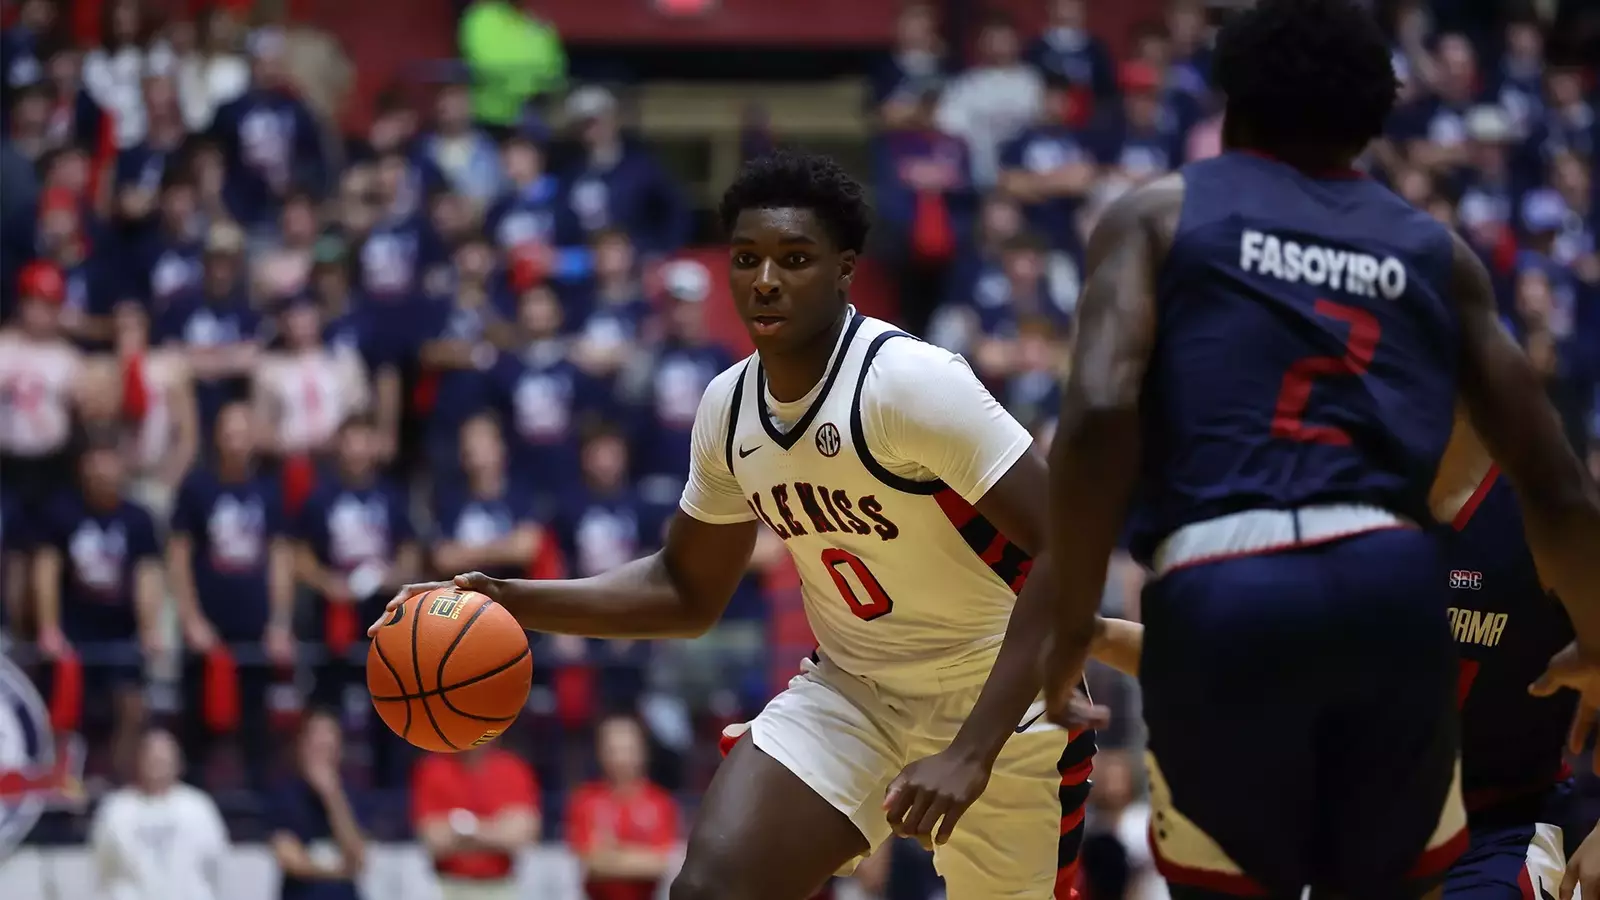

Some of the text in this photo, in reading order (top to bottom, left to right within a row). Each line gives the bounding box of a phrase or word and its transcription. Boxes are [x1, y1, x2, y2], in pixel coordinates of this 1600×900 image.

[1239, 228, 1406, 300] FASOYIRO
[1270, 298, 1382, 447] 2
[817, 424, 841, 456] SEC
[794, 482, 899, 541] MISS
[821, 547, 894, 622] 0
[1449, 569, 1483, 591] SBC
